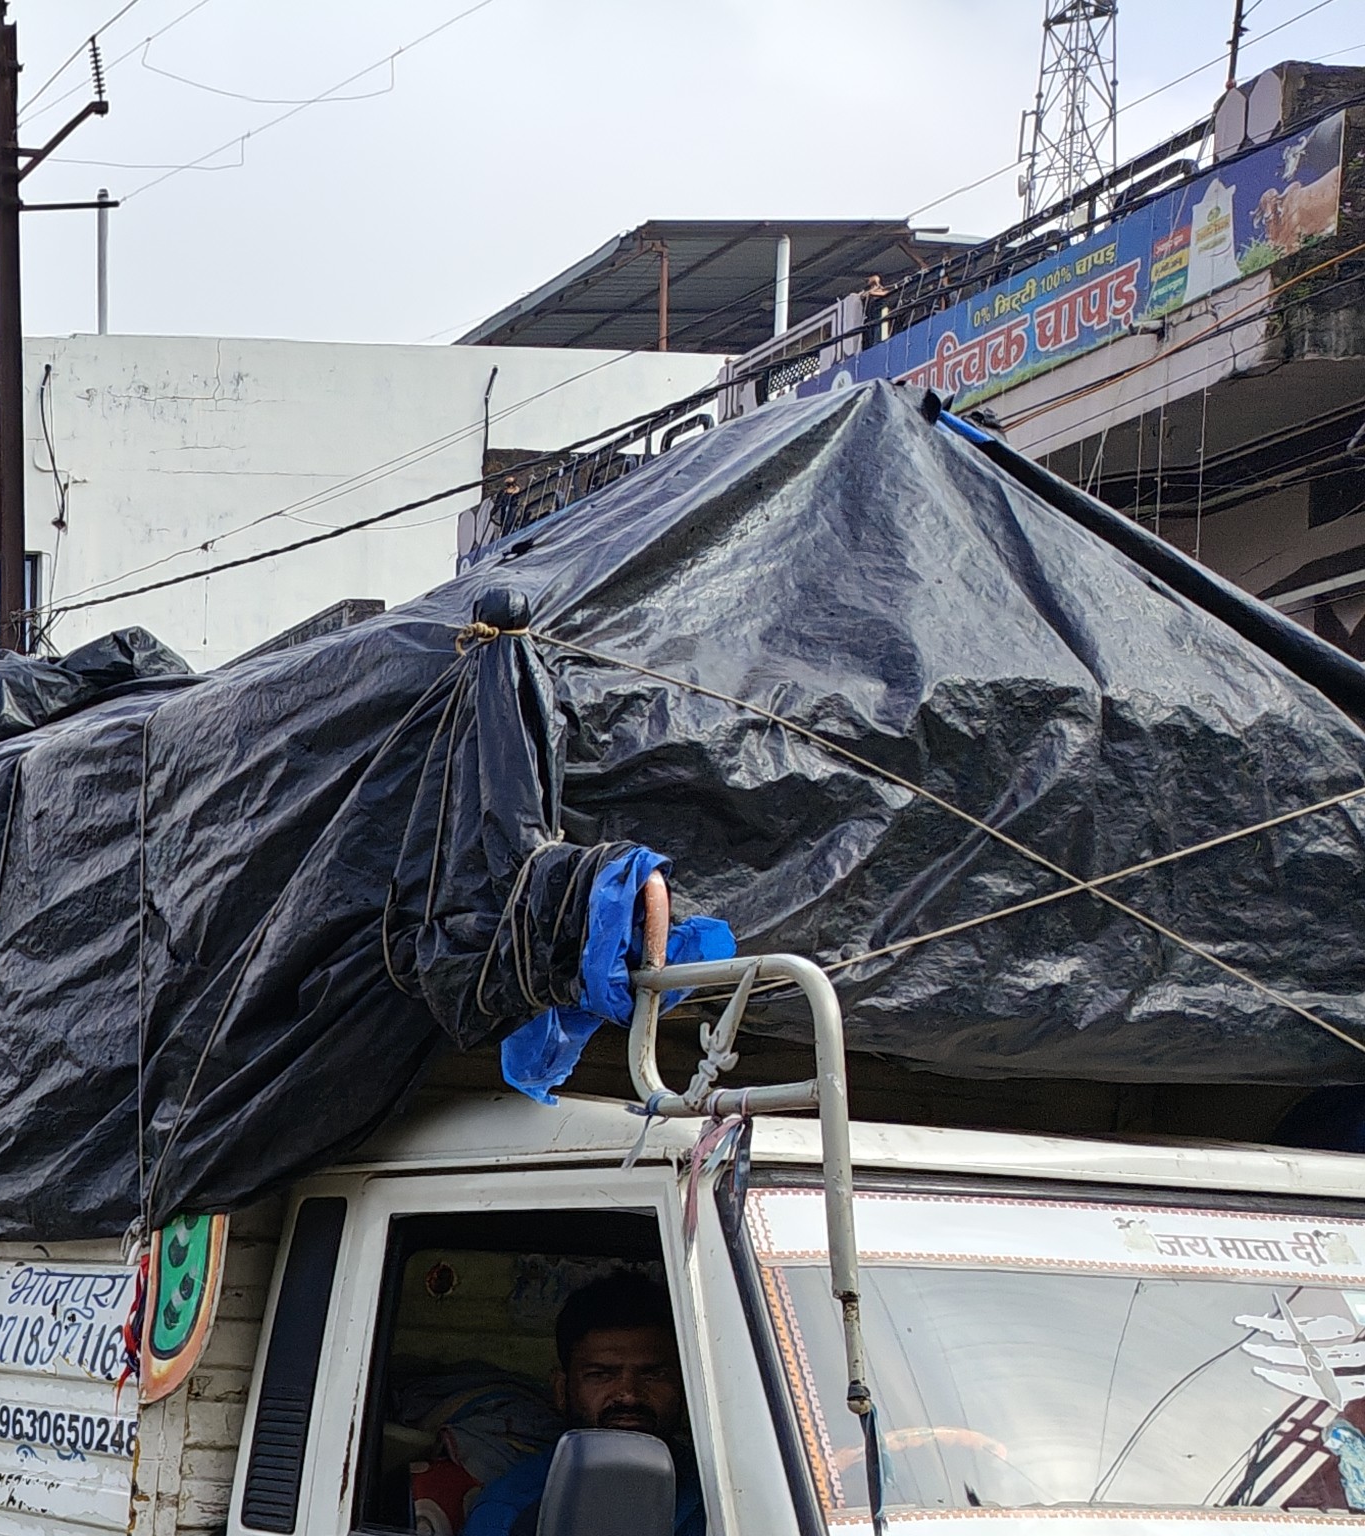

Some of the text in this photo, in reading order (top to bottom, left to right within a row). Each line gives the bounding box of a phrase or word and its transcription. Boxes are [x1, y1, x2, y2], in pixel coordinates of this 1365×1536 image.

[1154, 1231, 1328, 1267] जय माता दी
